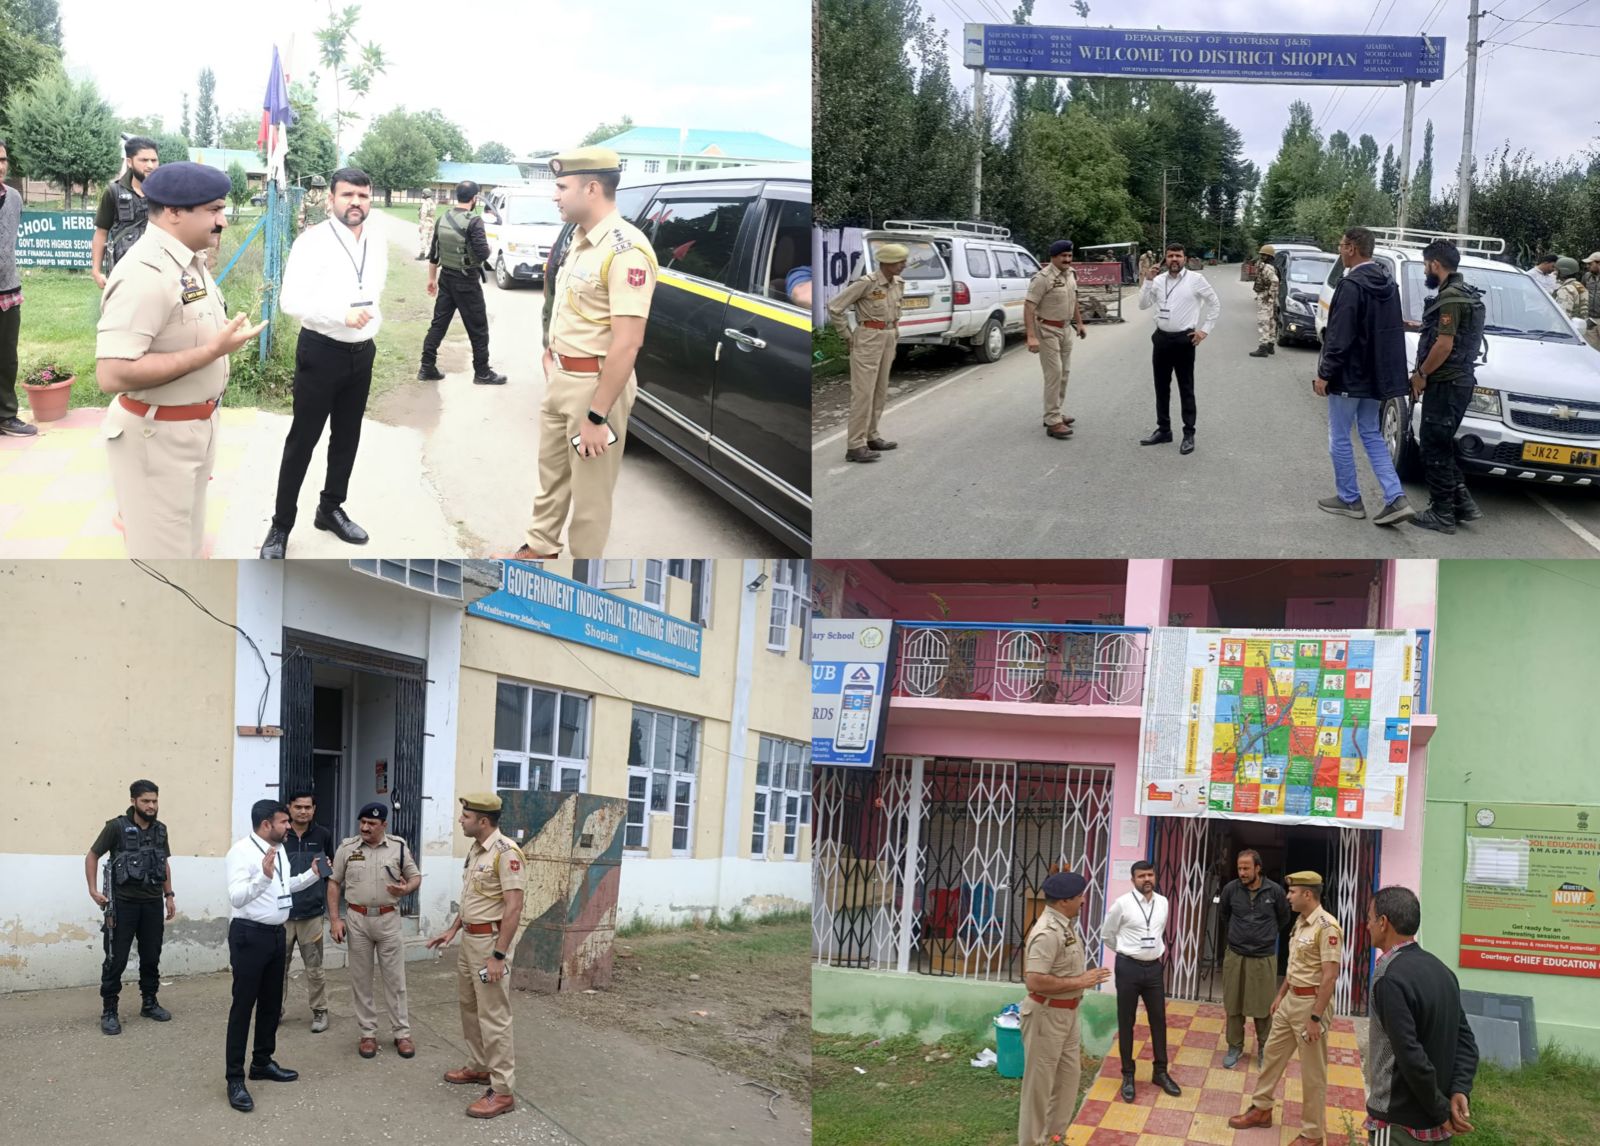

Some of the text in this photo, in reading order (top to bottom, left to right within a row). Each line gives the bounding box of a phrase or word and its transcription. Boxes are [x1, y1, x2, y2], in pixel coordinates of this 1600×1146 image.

[1124, 33, 1200, 43] DEPARTMENT
[1205, 36, 1222, 44] OF
[1227, 36, 1279, 45] TOURISM
[1078, 45, 1357, 67] WELCOME TO DISTRICT SHOPIAN
[36, 239, 50, 249] BOYS
[51, 239, 73, 249] HIGHER
[507, 566, 576, 613] GOVERNMENT
[576, 590, 627, 629] INDUSTRIAL
[628, 606, 664, 641] TRAINING
[665, 622, 699, 653] INSTITUTE
[584, 623, 619, 645] Shopian
[827, 631, 855, 641] School
[813, 664, 837, 681] UB
[812, 707, 834, 720] RDS
[1546, 840, 1597, 850] EDUCATION
[1529, 847, 1572, 856] AMAGRA
[1555, 891, 1587, 904] NOW!
[1525, 925, 1541, 933] ready
[1502, 930, 1535, 939] interesting
[1537, 933, 1560, 941] session
[1481, 952, 1597, 970] Courtesy: CHIEF EDUCATION
